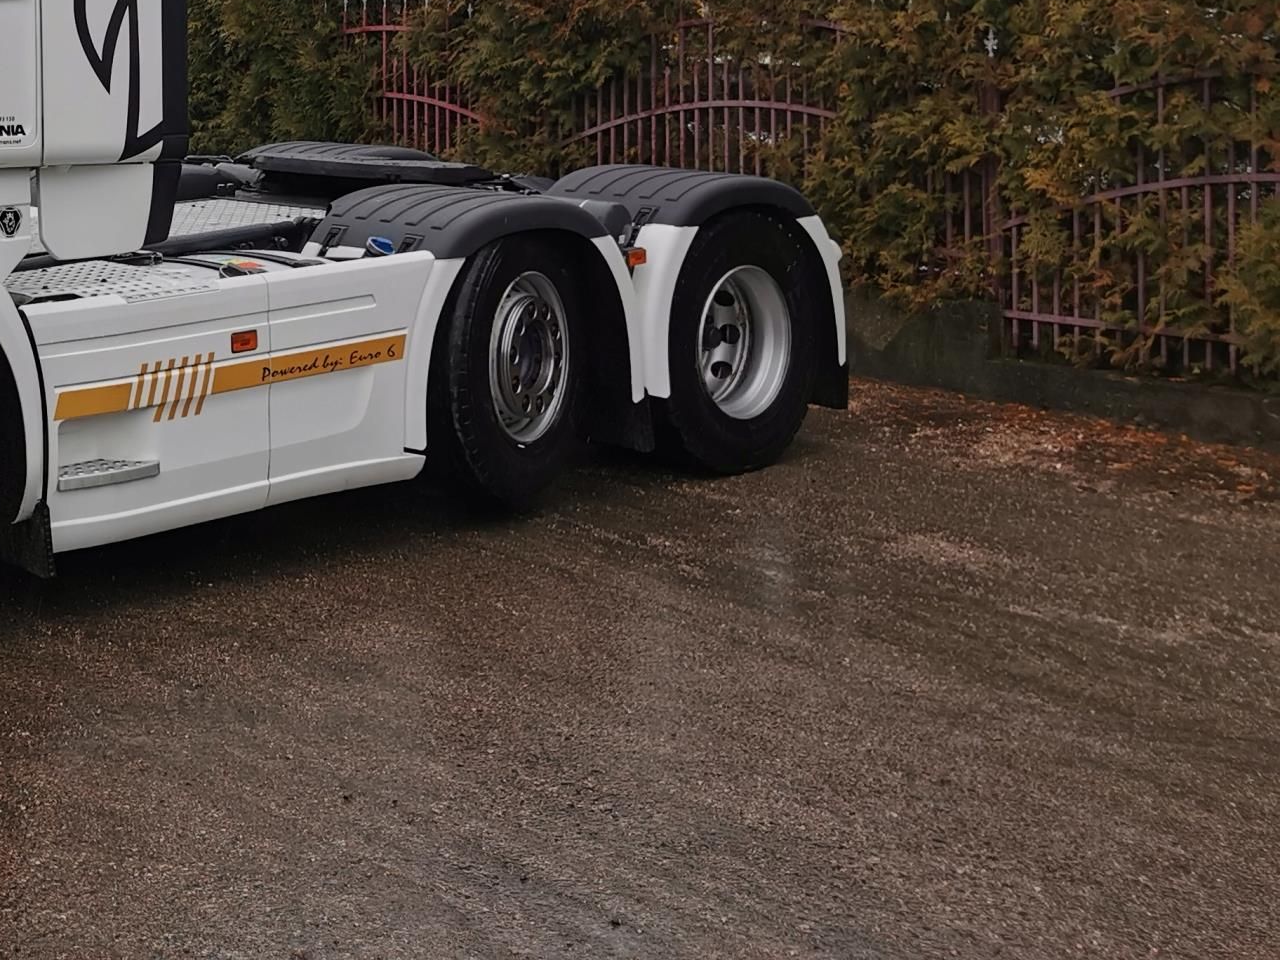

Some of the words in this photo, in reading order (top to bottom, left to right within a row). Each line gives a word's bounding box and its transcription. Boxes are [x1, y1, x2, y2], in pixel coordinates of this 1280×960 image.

[261, 357, 319, 381] Powered
[321, 354, 343, 373] by:
[349, 349, 382, 366] Euro
[386, 343, 396, 359] 6
